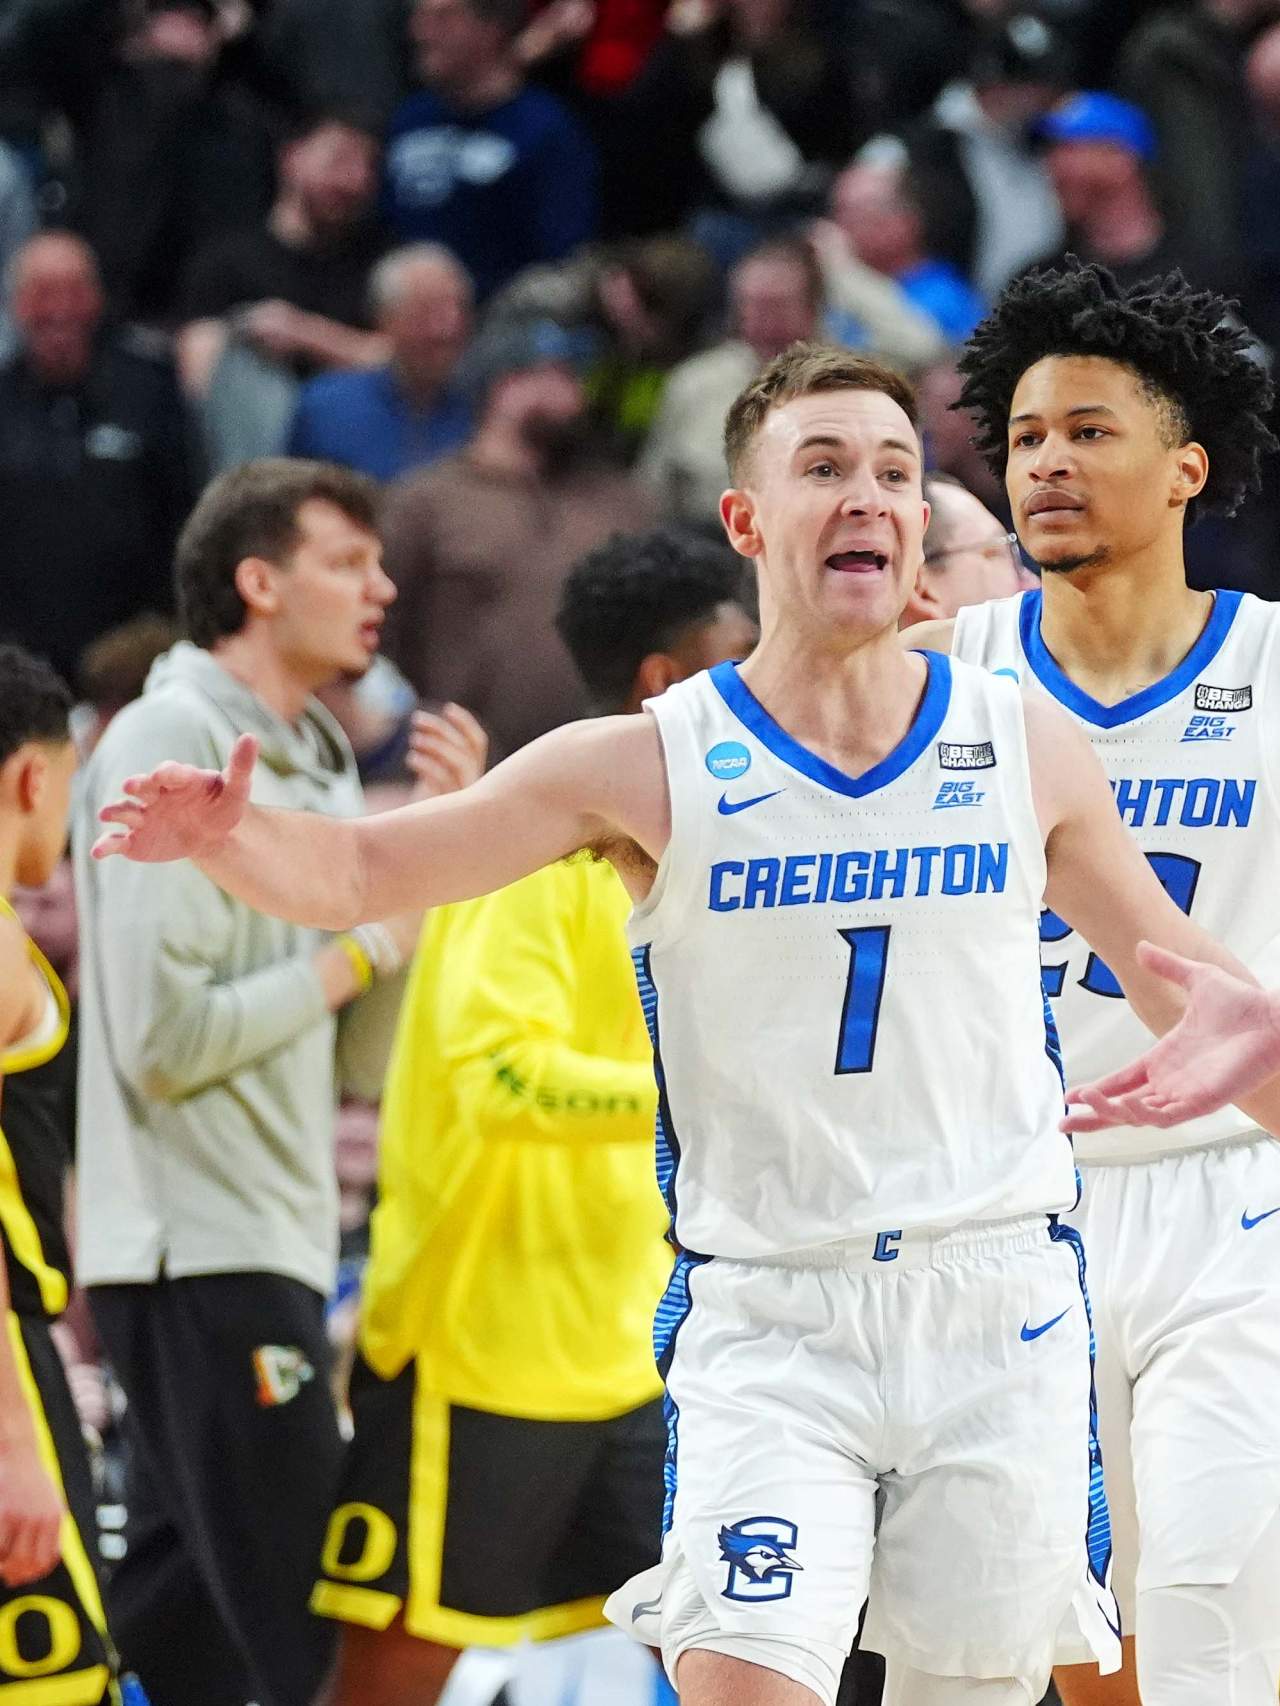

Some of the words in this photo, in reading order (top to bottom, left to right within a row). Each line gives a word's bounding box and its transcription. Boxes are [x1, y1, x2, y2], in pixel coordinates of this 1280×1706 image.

[1208, 687, 1234, 702] BE
[1196, 698, 1251, 710] CHANGE
[1189, 715, 1227, 727] BIG
[1183, 727, 1237, 738] EAST
[949, 744, 974, 759] BE
[712, 757, 748, 769] NCAA
[941, 756, 994, 768] CHANGE
[939, 781, 976, 793] BIG
[934, 792, 986, 804] EAST
[708, 843, 1009, 912] CREIGHTON
[834, 925, 892, 1076] 1
[871, 1229, 903, 1262] C
[320, 1501, 399, 1582] O
[0, 1594, 82, 1679] O
